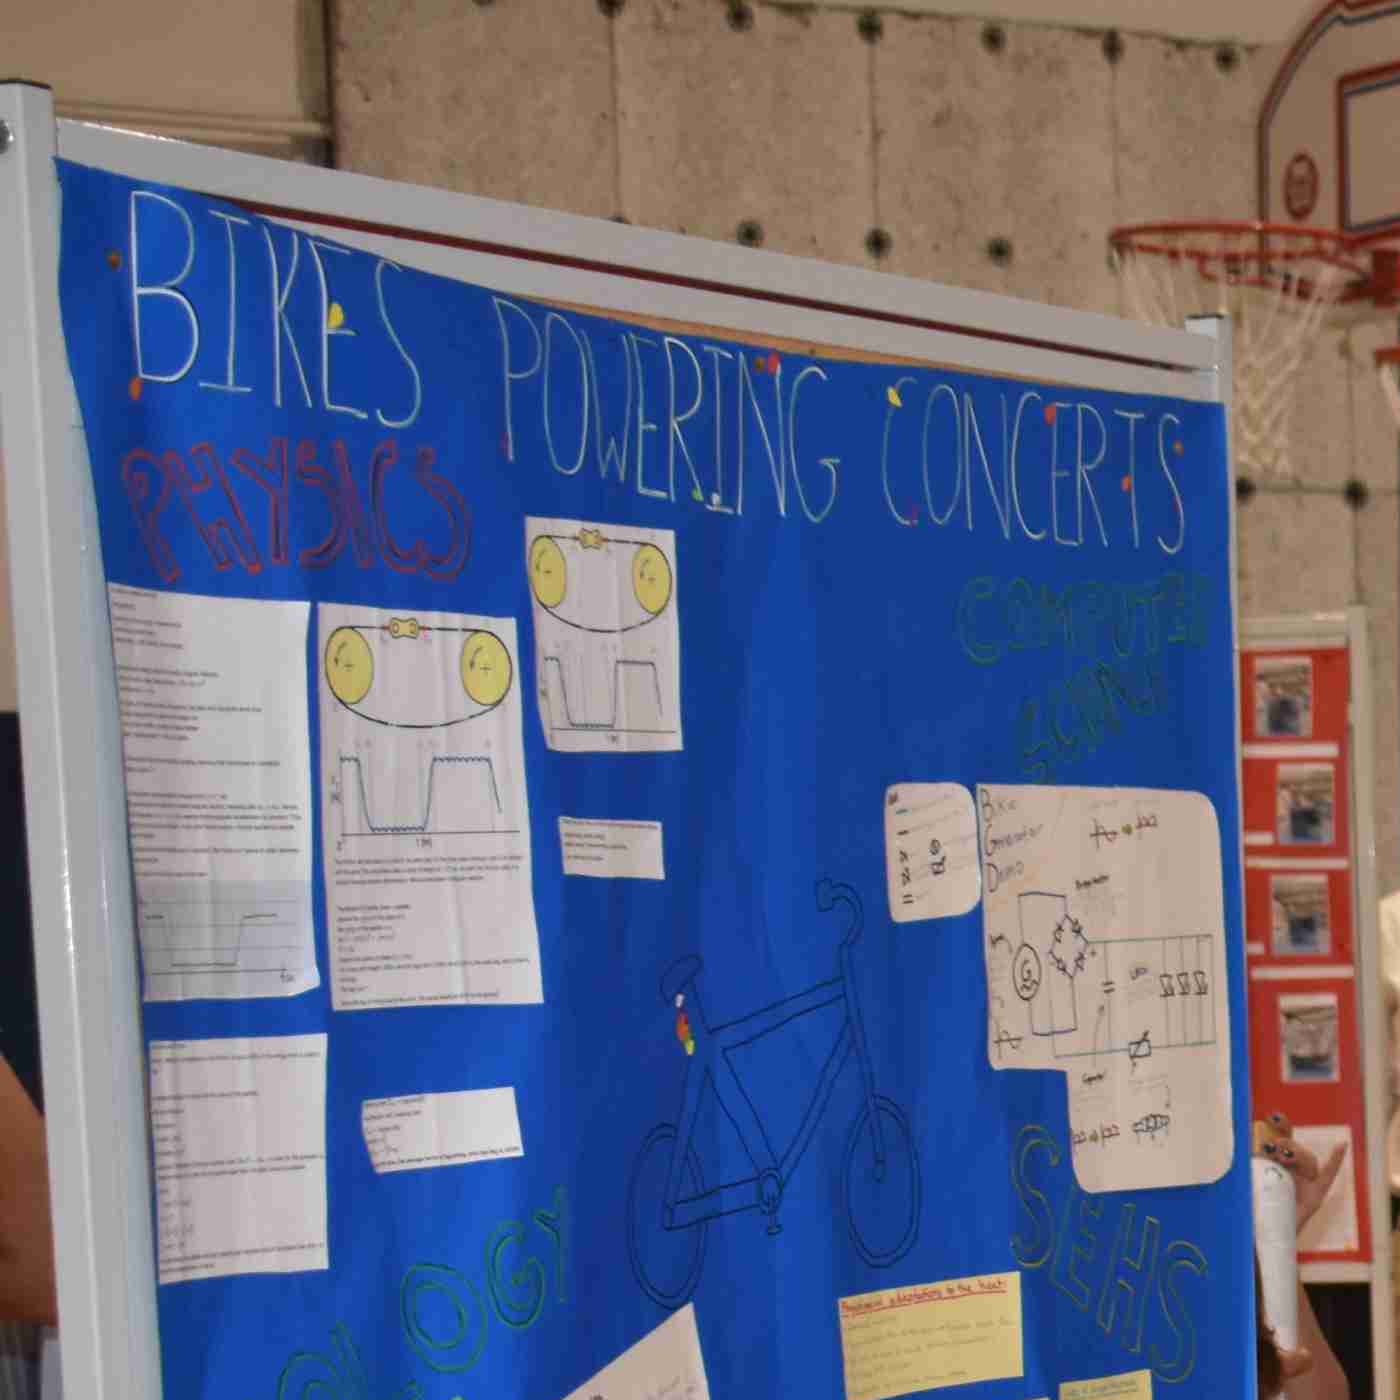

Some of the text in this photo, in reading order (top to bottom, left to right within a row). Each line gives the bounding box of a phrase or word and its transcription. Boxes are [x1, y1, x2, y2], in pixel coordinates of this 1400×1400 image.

[131, 190, 1186, 554] BIKES POWERING CONCERTS
[121, 437, 472, 583] PHYSICS
